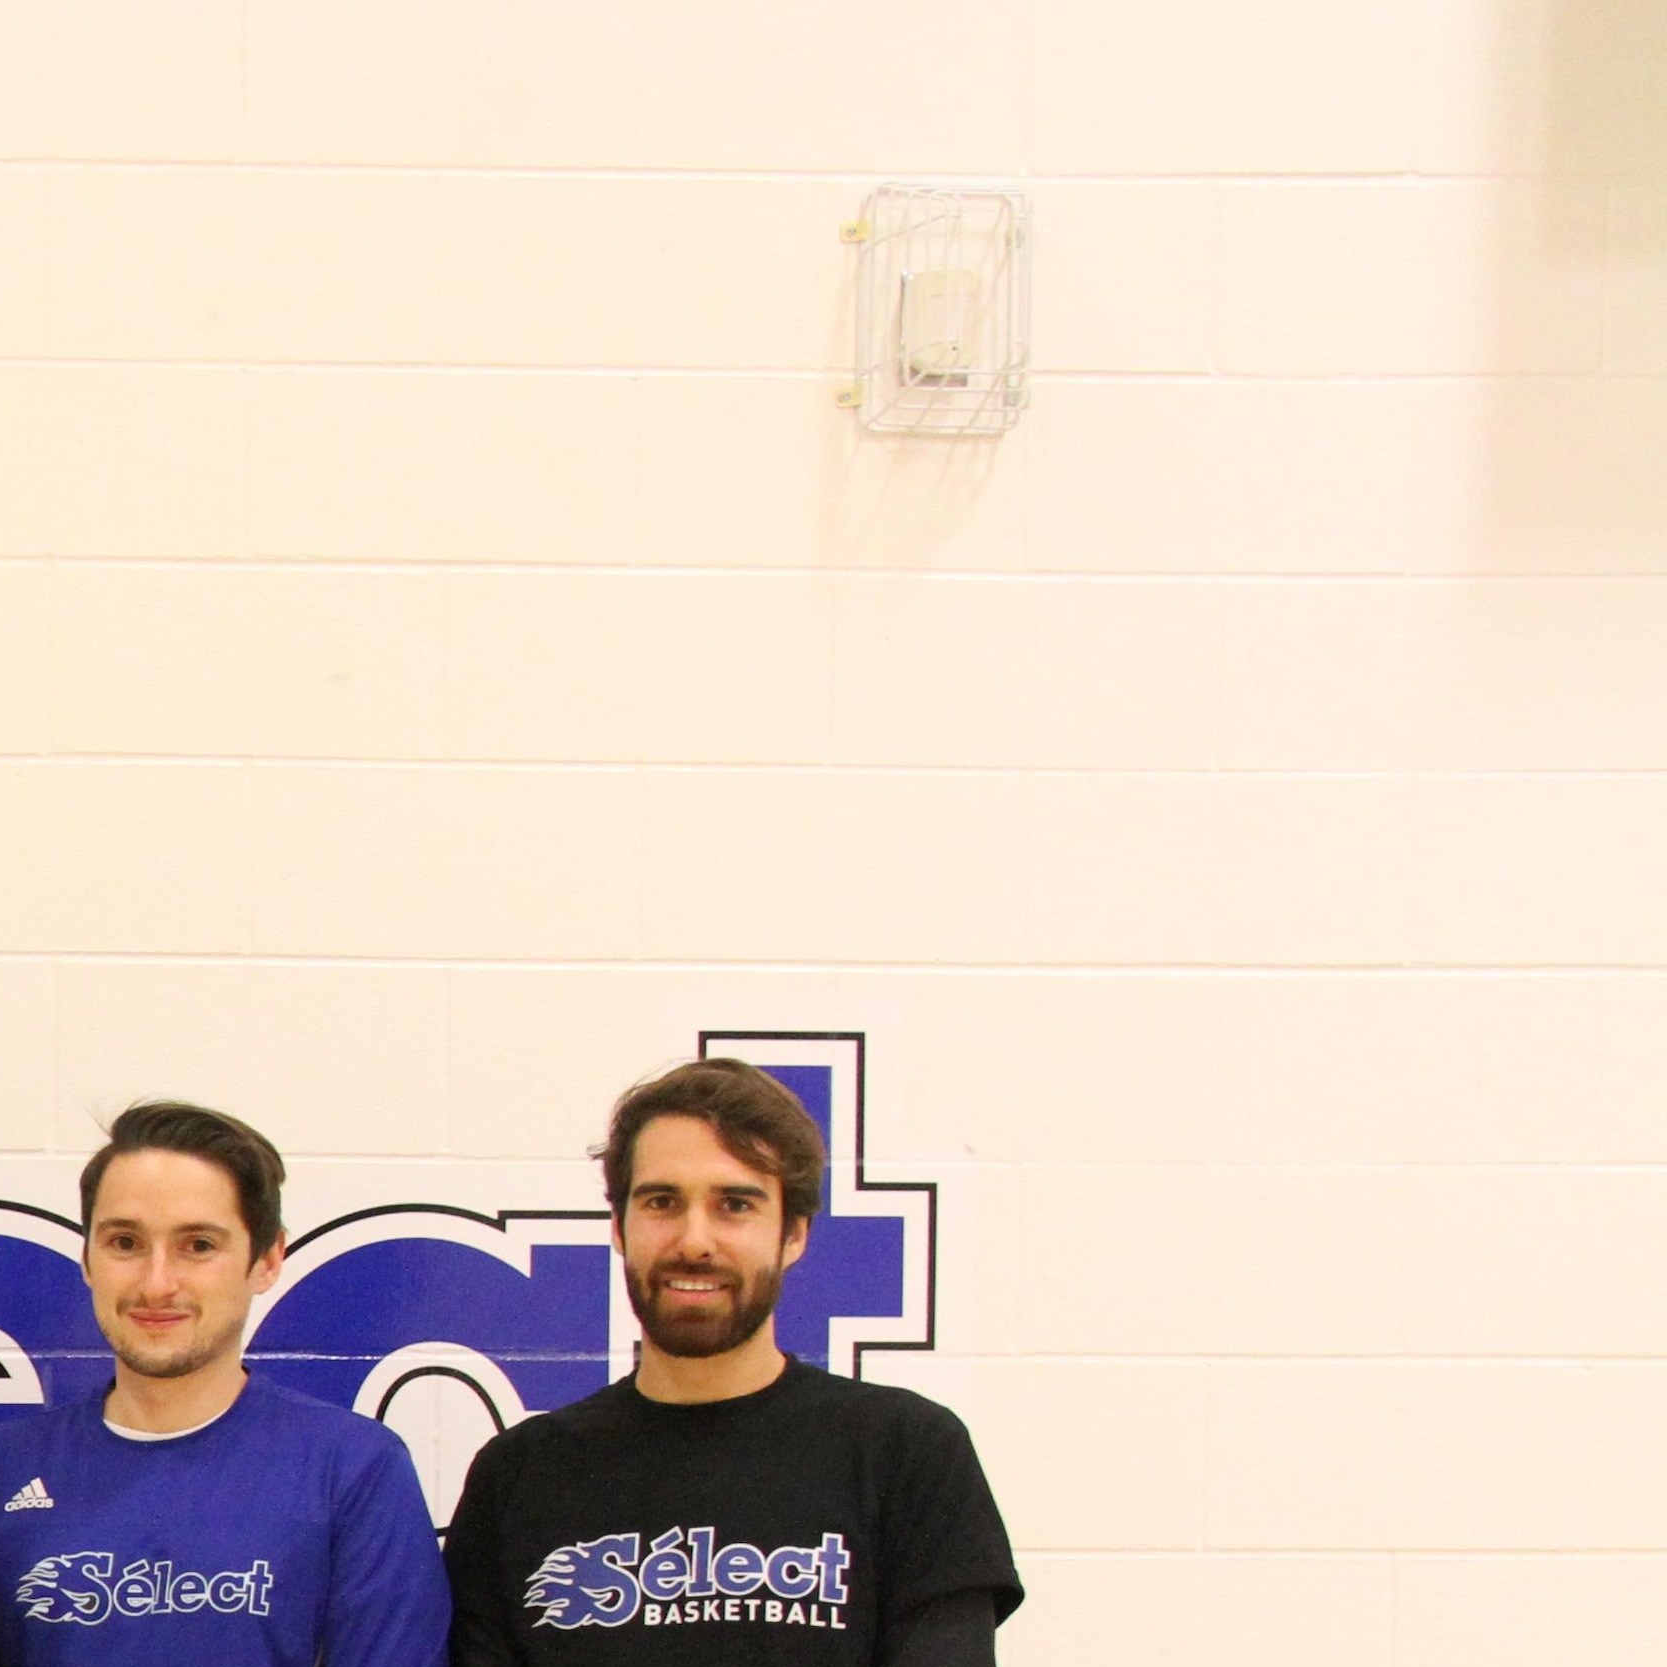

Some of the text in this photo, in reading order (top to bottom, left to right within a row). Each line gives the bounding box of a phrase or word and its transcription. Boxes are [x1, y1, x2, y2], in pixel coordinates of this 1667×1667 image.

[16, 1551, 273, 1626] Sélect
[523, 1525, 850, 1630] Sélect
[644, 1599, 847, 1629] BASKETBALL
